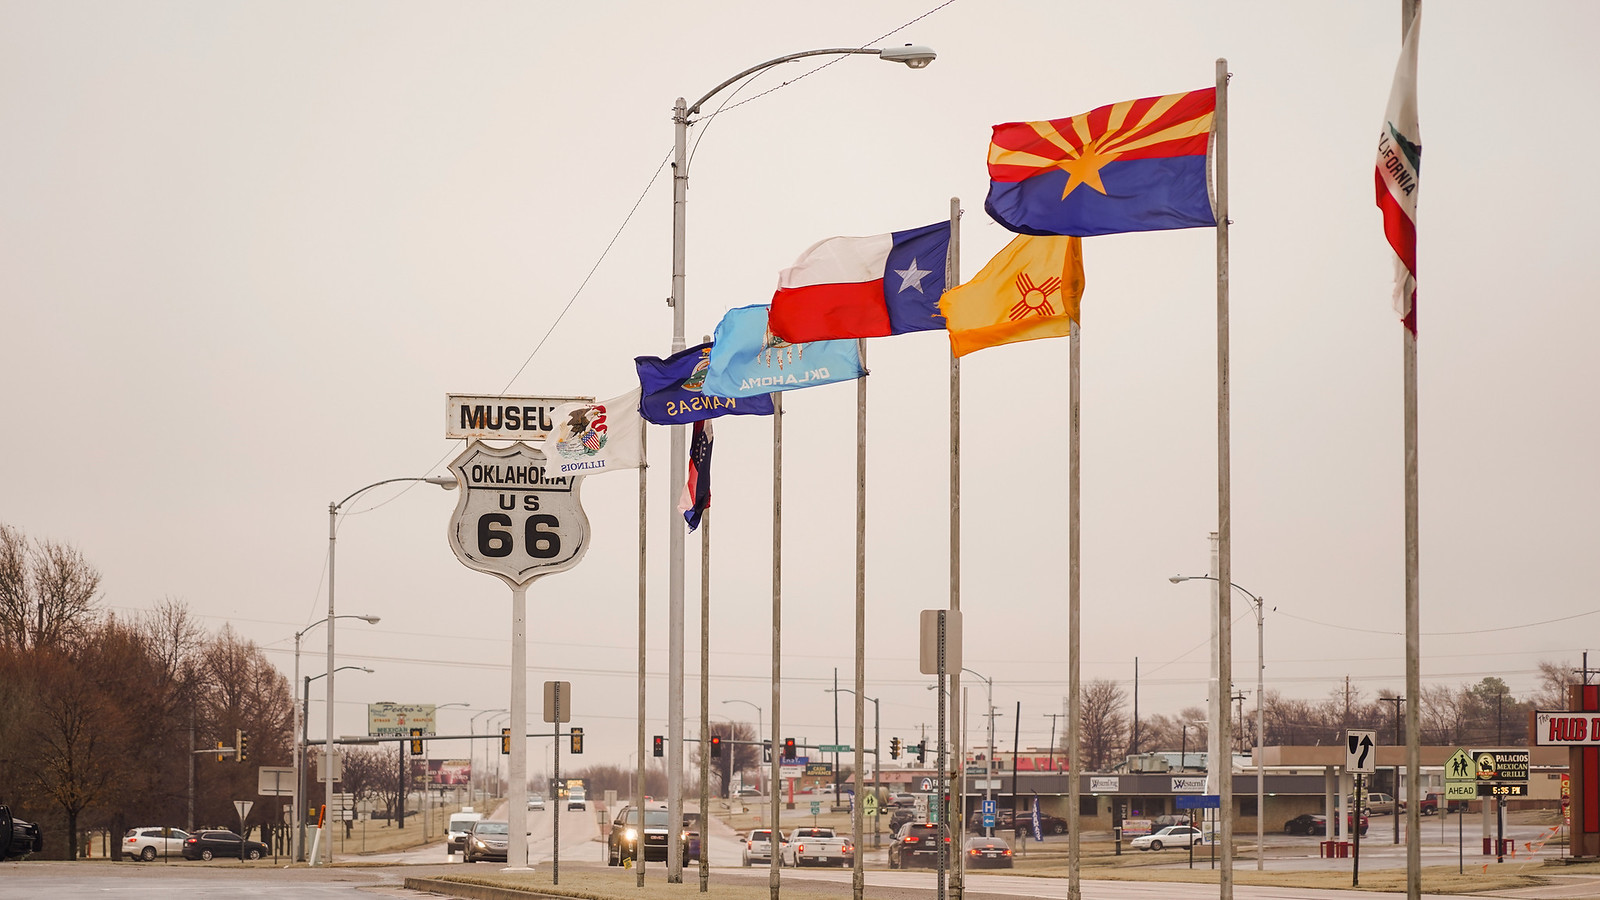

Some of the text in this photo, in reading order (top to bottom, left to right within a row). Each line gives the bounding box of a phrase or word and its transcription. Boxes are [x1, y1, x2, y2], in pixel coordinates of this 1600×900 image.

[1378, 132, 1416, 196] LIFORNIA
[460, 405, 556, 432] MUSEU
[478, 513, 561, 558] 66
[1538, 714, 1549, 725] The
[1549, 718, 1588, 741] HUB
[1492, 786, 1509, 794] 5:35
[985, 802, 994, 812] H
